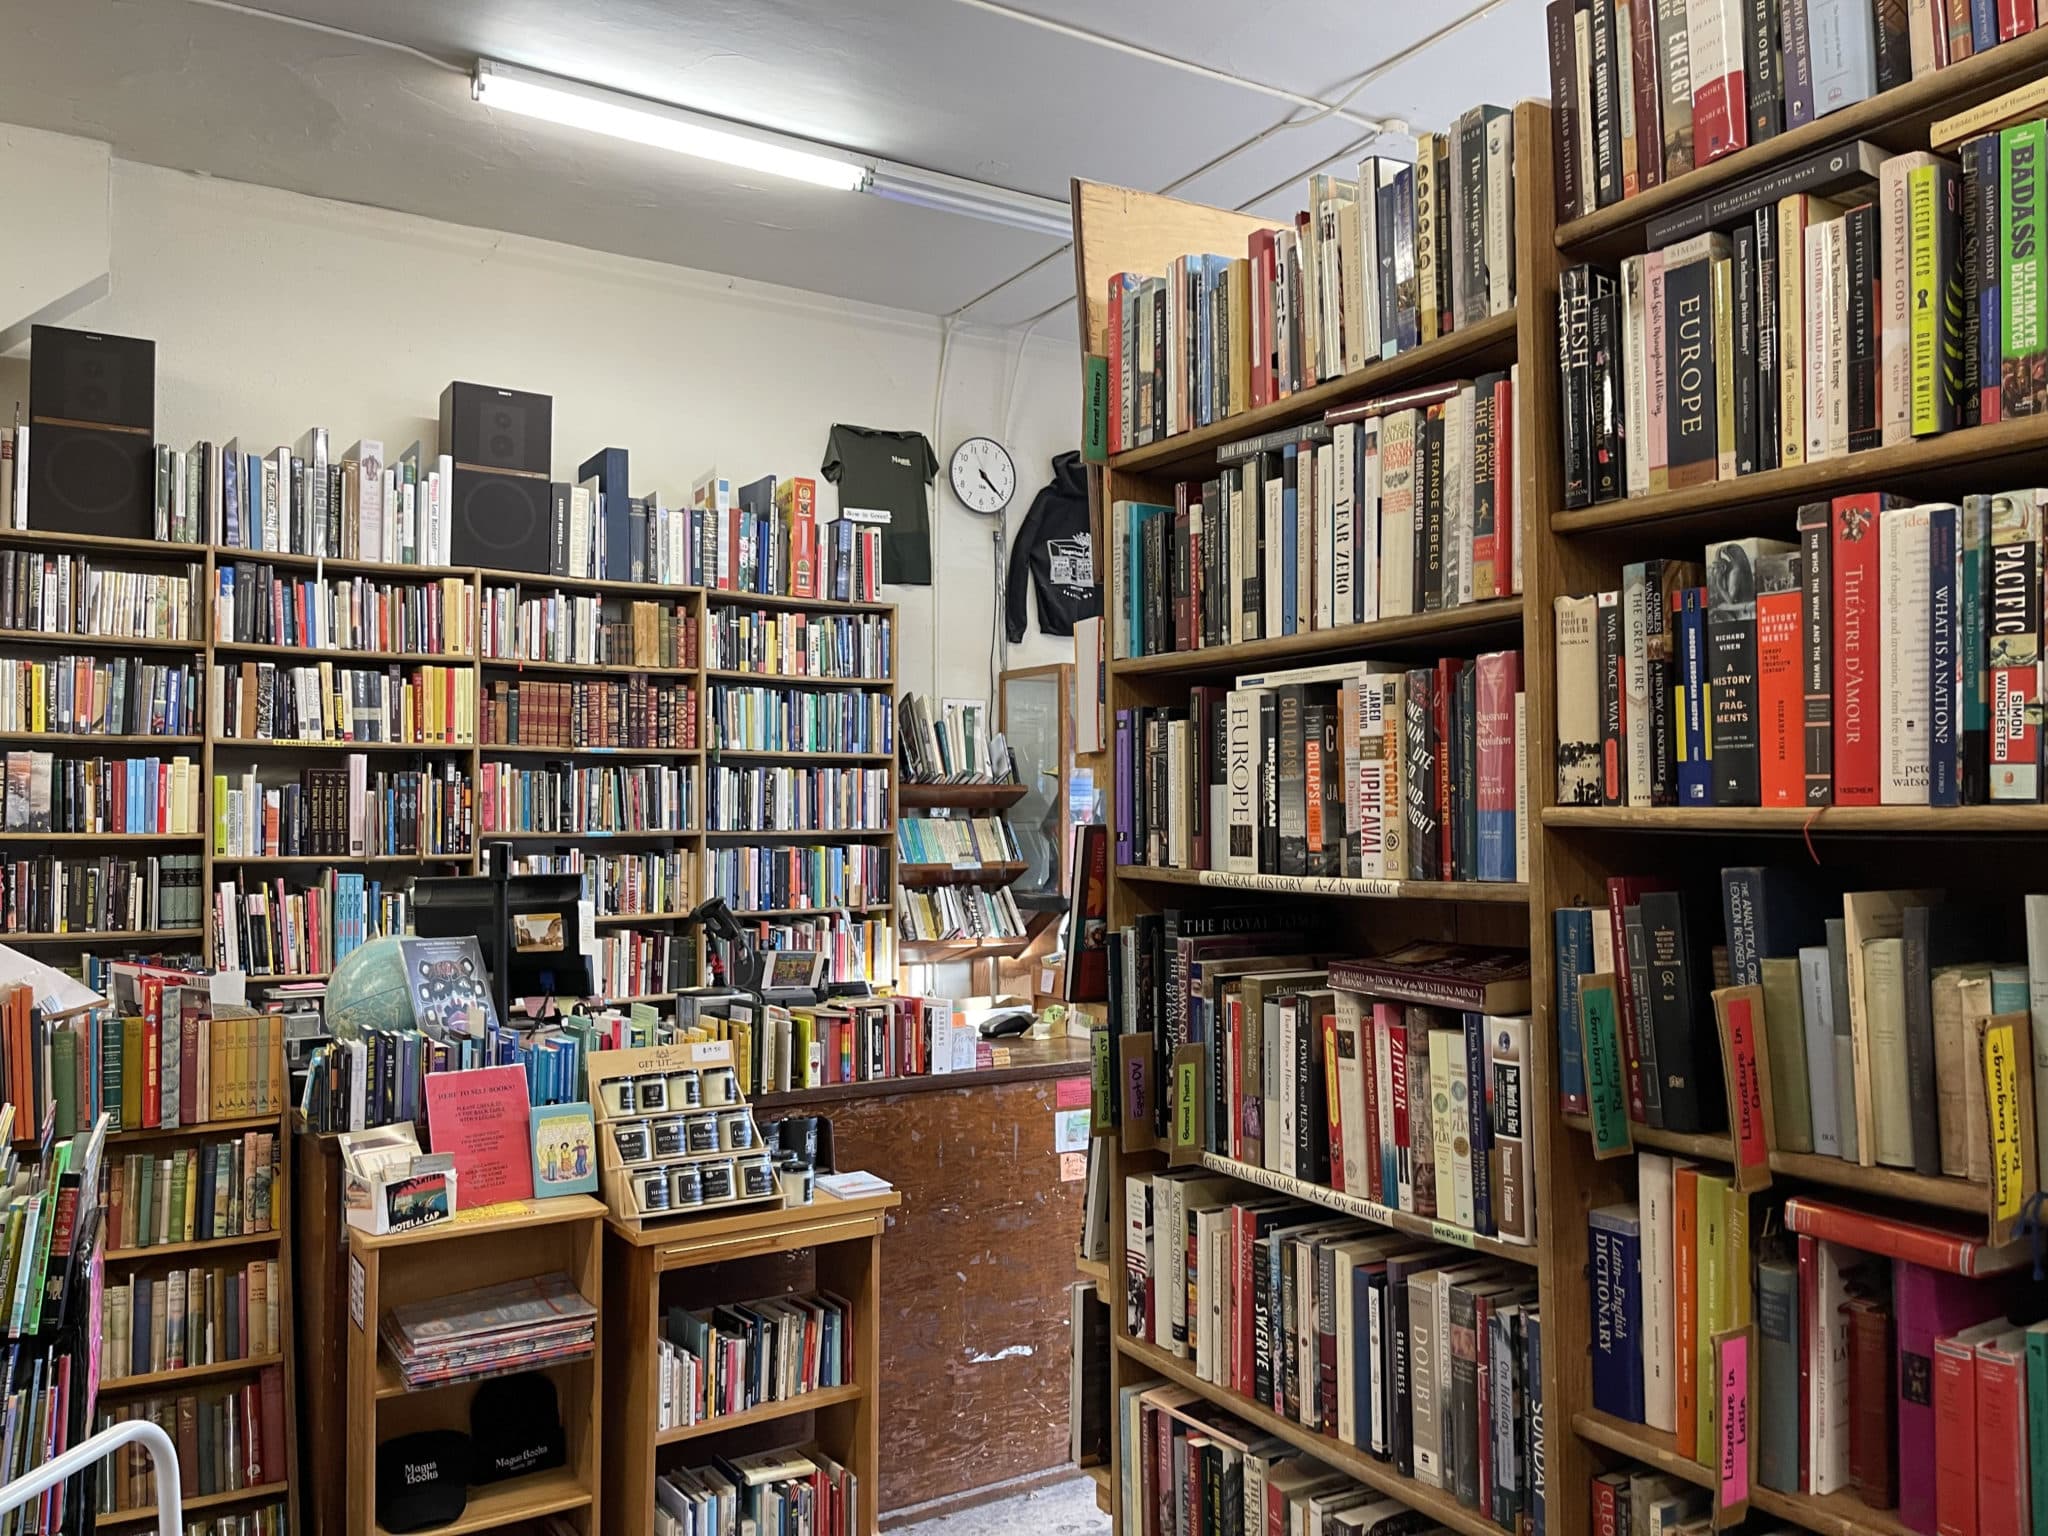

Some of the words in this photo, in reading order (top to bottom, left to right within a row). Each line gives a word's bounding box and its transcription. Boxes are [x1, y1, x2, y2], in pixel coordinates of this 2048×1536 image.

[1668, 32, 1691, 104] ENERGY
[1595, 62, 1608, 119] CHURCHILL
[1598, 120, 1609, 129] &
[1471, 152, 1481, 181] The
[1598, 130, 1610, 170] ORWELL
[1712, 201, 1728, 212] THE
[1729, 190, 1762, 206] DECLINE
[1764, 183, 1775, 193] OF
[1777, 175, 1793, 187] THE
[1796, 167, 1816, 180] WEST
[1984, 184, 1995, 232] SHAPING
[2010, 145, 2035, 260] BADASS
[1470, 184, 1482, 235] Vertigo
[1854, 213, 1863, 237] THE
[1894, 179, 1905, 275] ACCIDENTAL
[1915, 181, 1930, 240] SKELETON
[1831, 225, 1840, 246] 1848:
[1472, 238, 1483, 278] Years
[1831, 248, 1840, 264] The
[1854, 241, 1864, 286] FUTURE
[1916, 248, 1930, 277] KEYS
[1985, 234, 1995, 281] HISTORY
[1830, 266, 1841, 325] Revolutionary
[1855, 300, 1864, 322] THE
[1894, 280, 1905, 321] GODS
[2010, 263, 2024, 350] DEATHMATCH
[2023, 259, 2038, 348] ULTIMATE
[1570, 294, 1589, 369] FLESH
[1592, 306, 1601, 346] SHEEHAN
[1599, 314, 1608, 335] NEIL
[1832, 328, 1841, 346] Tide
[1855, 326, 1865, 356] PAST
[1679, 294, 1703, 436] EUROPE
[1832, 348, 1841, 357] in
[1092, 370, 1104, 398] History
[1785, 372, 1795, 386] Tom
[1830, 359, 1841, 390] Europe
[1091, 402, 1103, 447] General
[1475, 399, 1488, 428] THE
[1784, 388, 1795, 437] Standage
[1430, 441, 1440, 508] STRANGE
[1475, 433, 1488, 484] EARTH
[1415, 449, 1424, 531] CORKSCREWED
[1336, 498, 1350, 542] YEAR
[1429, 514, 1440, 571] REBELS
[1810, 534, 1818, 549] THE
[1336, 550, 1350, 595] ZERO
[1810, 551, 1819, 575] WHO,
[1632, 592, 1643, 615] THE
[1645, 580, 1653, 599] VAN
[1811, 578, 1819, 594] THE
[1995, 544, 2026, 634] PACIFIC
[1646, 601, 1655, 634] DOREN
[1653, 592, 1661, 633] CHARLES
[1811, 595, 1820, 622] WHAT,
[1935, 585, 1948, 636] WHAT
[1607, 614, 1618, 642] WAR
[1633, 620, 1644, 661] GREAT
[1688, 627, 1696, 660] MODERN
[1812, 623, 1821, 644] AND
[1935, 639, 1948, 655] IS
[1607, 653, 1618, 691] PEACE
[1655, 662, 1663, 670] A
[1726, 663, 1734, 673] A
[1812, 646, 1821, 662] THE
[1935, 659, 1948, 672] A
[1634, 665, 1645, 692] FIRE
[1655, 672, 1665, 709] HISTORY
[1689, 661, 1698, 699] EUROPEAN
[1712, 676, 1752, 685] HISTORY
[1725, 689, 1736, 697] IN
[1812, 664, 1822, 690] WHEN
[1369, 690, 1382, 721] JARED
[1608, 701, 1619, 733] WAR
[1656, 714, 1664, 726] OF
[1691, 700, 1699, 731] HISTORY
[1716, 715, 1748, 723] MENTS
[1719, 702, 1747, 710] FRAG-
[1935, 676, 1948, 745] NATION?
[1996, 674, 2007, 758] WINCHESTER
[2010, 695, 2022, 737] SIMON
[1232, 709, 1249, 822] EUROPE
[1656, 728, 1667, 782] KNOWLEDGE
[1268, 737, 1276, 827] INHUMAN
[1307, 742, 1321, 807] COLLAPSE
[1441, 742, 1449, 826] FIRECRACKERS
[1360, 767, 1382, 857] UPHEAVAL
[1206, 873, 1255, 888] GENERAL
[1257, 876, 1305, 892] HISTORY
[1314, 879, 1336, 893] A-Z
[1339, 879, 1352, 895] by
[1355, 880, 1392, 895] author
[1729, 881, 1742, 924] LEXICON
[1740, 882, 1749, 897] THE
[1733, 926, 1745, 968] REVISED
[1741, 899, 1754, 959] ANALYTICAL
[1177, 951, 1186, 980] THE
[1748, 962, 1757, 985] GRE
[1177, 983, 1187, 1021] DAWN
[1177, 1023, 1187, 1043] OF
[1469, 1025, 1478, 1053] Thank
[1588, 1008, 1603, 1086] Language
[638, 1060, 655, 1069] GET
[1299, 1038, 1308, 1083] POWER
[1391, 1038, 1407, 1110] ZIPPER
[1470, 1055, 1479, 1071] You
[1506, 1069, 1517, 1083] The
[1612, 1031, 1622, 1112] Reference
[1470, 1073, 1480, 1087] for
[1507, 1084, 1518, 1108] World
[1992, 1042, 2006, 1144] Language
[1470, 1088, 1480, 1114] Being
[1299, 1103, 1309, 1152] PLENTY
[1472, 1116, 1481, 1136] Late
[1508, 1119, 1519, 1133] Flat
[2010, 1071, 2021, 1176] Reference
[1203, 1154, 1254, 1181] GENERAL
[1254, 1166, 1304, 1193] HISTORY
[1308, 1183, 1332, 1204] A-Z
[1334, 1191, 1349, 1209] by
[1350, 1199, 1387, 1221] author
[1998, 1152, 2007, 1206] Latin
[424, 1211, 440, 1222] CAP
[1595, 1233, 1612, 1354] DICTIONARY
[1255, 1303, 1269, 1371] SWERVE
[1395, 1330, 1406, 1395] GREATNESS
[1412, 1325, 1431, 1422] DOUBT
[1500, 1360, 1511, 1380] On
[1499, 1384, 1512, 1439] Holiday
[1736, 1395, 1746, 1445] Latin
[1531, 1399, 1546, 1501] SUNDAY
[1722, 1394, 1736, 1481] Literature
[405, 1461, 437, 1477] Magus
[496, 1454, 523, 1469] Magus
[523, 1446, 548, 1460] Books
[407, 1470, 438, 1484] Books
